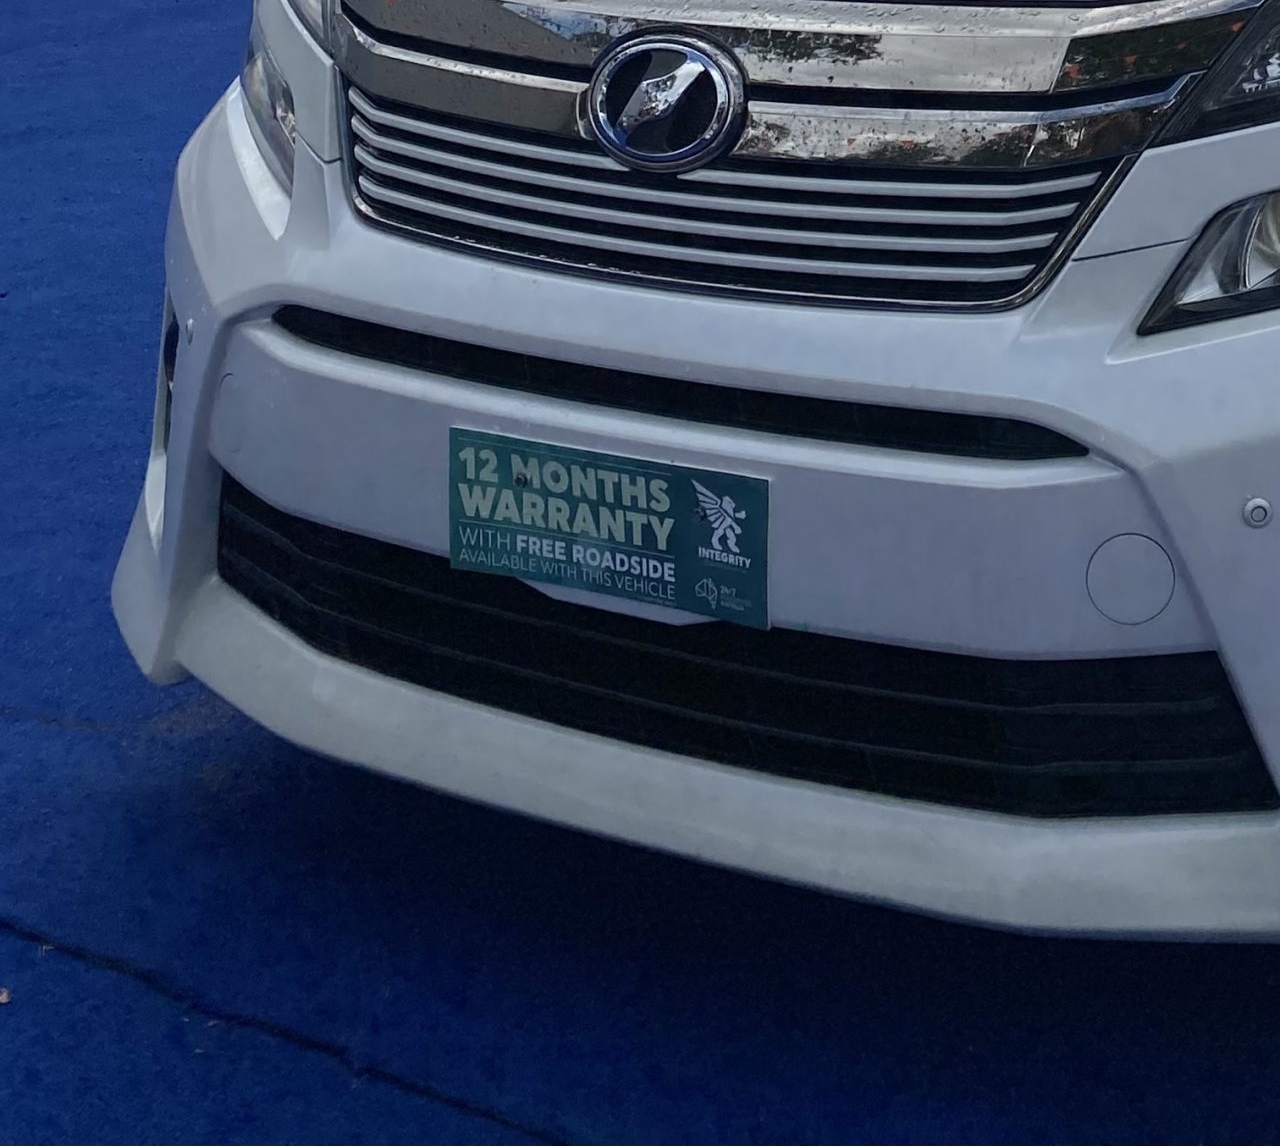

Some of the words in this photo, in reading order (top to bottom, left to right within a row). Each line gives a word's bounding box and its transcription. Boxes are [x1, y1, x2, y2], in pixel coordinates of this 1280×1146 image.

[458, 446, 498, 483] 12
[510, 453, 670, 512] MONTHS
[457, 483, 676, 551] WARRANTY
[459, 526, 510, 551] WITH
[516, 534, 566, 561] FREE
[572, 545, 676, 582] ROADSIDE
[459, 548, 537, 572] AVAILABLE
[540, 560, 577, 580] WITH
[582, 567, 612, 587] THIS
[614, 575, 676, 600] VEHICLE
[698, 546, 752, 568] INTEGRITY
